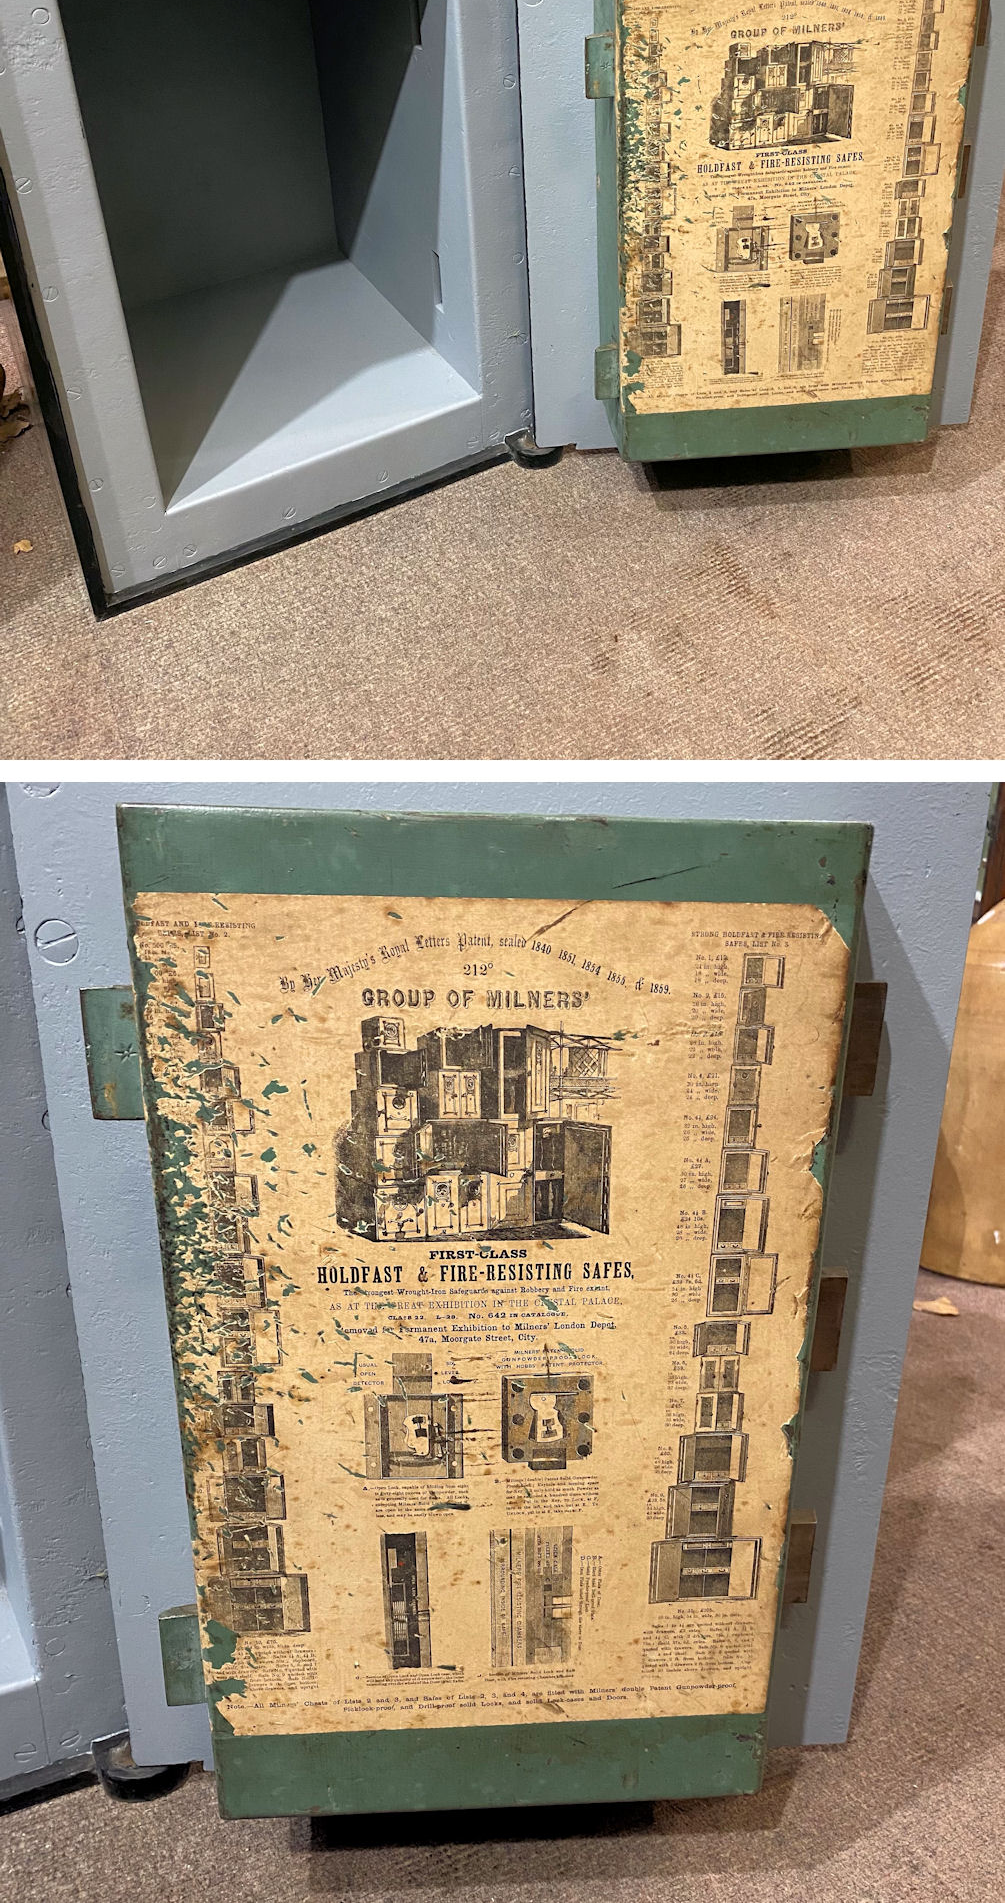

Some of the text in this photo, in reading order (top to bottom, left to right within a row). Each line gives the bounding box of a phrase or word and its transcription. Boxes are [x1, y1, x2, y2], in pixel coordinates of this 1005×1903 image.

[730, 28, 767, 39] GROUP
[773, 26, 787, 37] OF
[697, 161, 742, 174] HOLDFAST
[749, 160, 755, 170] &
[761, 154, 832, 169] FIRE-RESISTING
[326, 953, 377, 985] Majesty's
[378, 938, 410, 964] Royal
[414, 934, 451, 951] Letters
[499, 936, 527, 949] sealed
[650, 982, 671, 996] 1859.
[463, 962, 494, 976] 212°
[361, 988, 590, 1011] GROUP OF MILNERS'
[428, 1249, 528, 1260] FIRST-CLASS
[316, 1261, 635, 1284] HOLDFAST & FIRE-RESISTING SAFES,
[396, 1288, 447, 1297] Wrought-Iron
[491, 1287, 518, 1296] against
[520, 1285, 550, 1295] Robbery
[552, 1285, 566, 1293] and
[330, 1303, 342, 1311] AS
[347, 1303, 360, 1311] AT
[428, 1300, 487, 1310] EXHIBITION
[493, 1299, 504, 1308] IN
[510, 1299, 529, 1307] THE
[338, 1325, 379, 1335] emoved
[451, 1323, 498, 1333] Exhibition
[514, 1322, 551, 1331] Milners'
[553, 1321, 585, 1330] London
[418, 1333, 539, 1344] 47a, Moorgate Street, City.
[303, 1699, 329, 1707] Chests
[405, 1695, 419, 1703] and
[423, 1694, 442, 1702] Safes
[589, 1685, 618, 1694] Milners'
[650, 1684, 672, 1692] Patent
